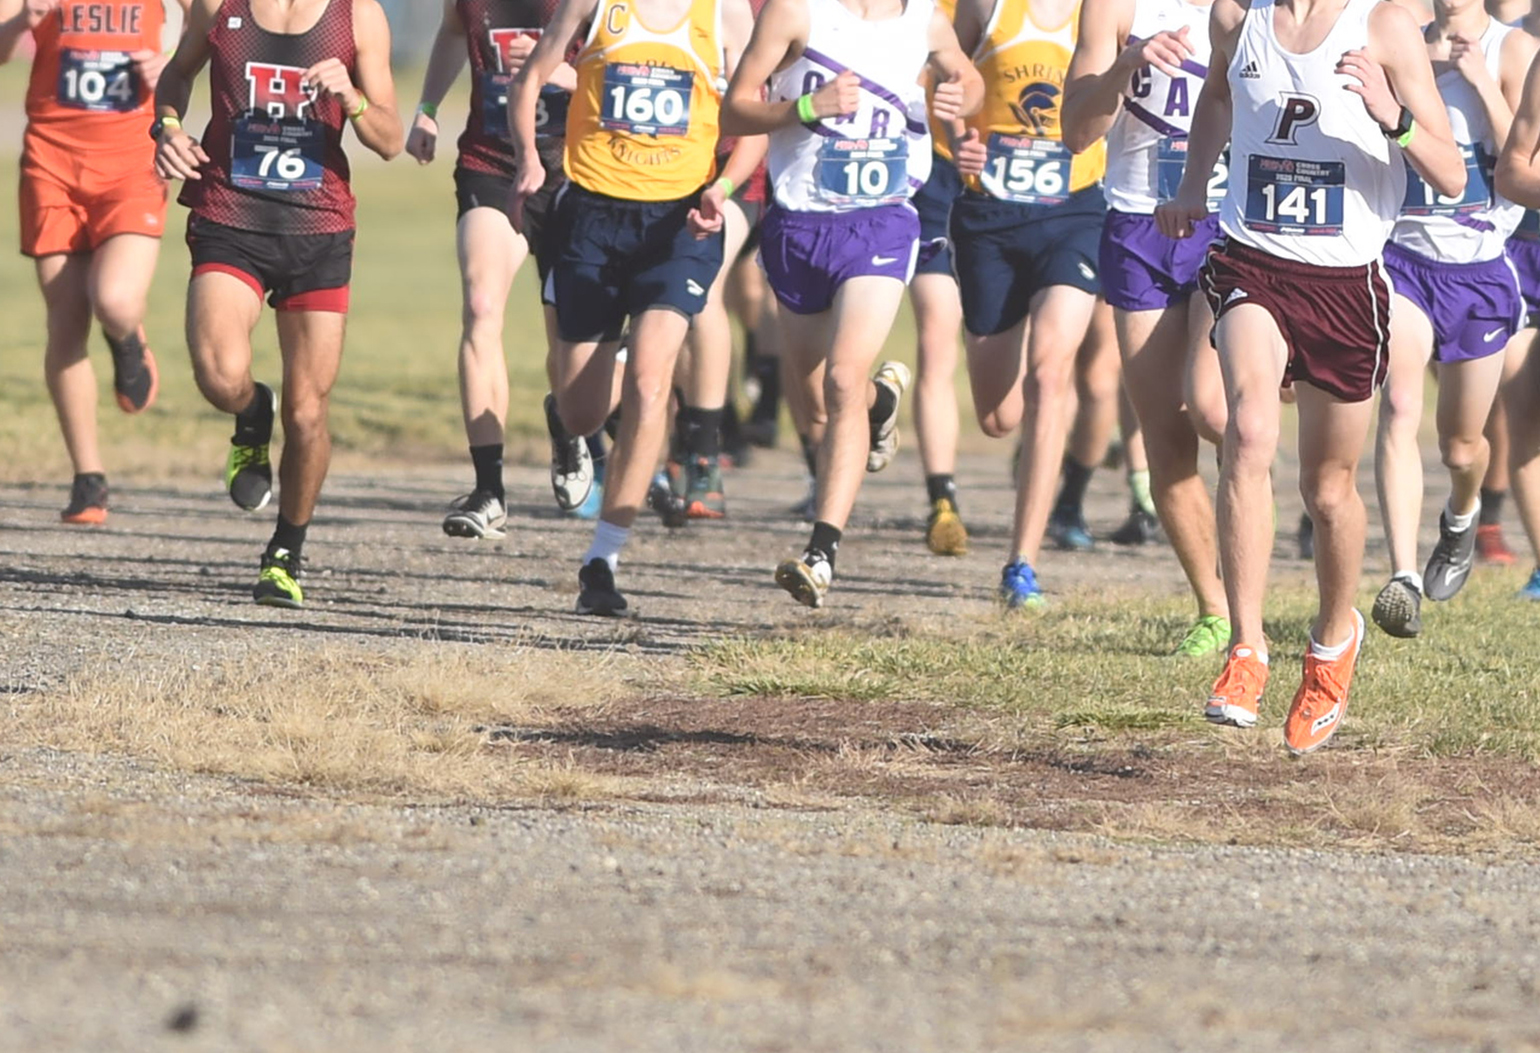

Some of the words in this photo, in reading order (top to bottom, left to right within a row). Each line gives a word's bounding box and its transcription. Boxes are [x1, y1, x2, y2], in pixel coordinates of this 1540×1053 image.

[58, 4, 142, 35] LESLIE
[607, 5, 626, 35] C
[65, 69, 132, 102] 104
[245, 62, 318, 125] H
[611, 86, 684, 126] 160
[1264, 91, 1322, 146] P
[254, 145, 306, 180] 76
[843, 160, 889, 196] 10
[993, 157, 1063, 195] 156
[1262, 184, 1327, 225] 141
